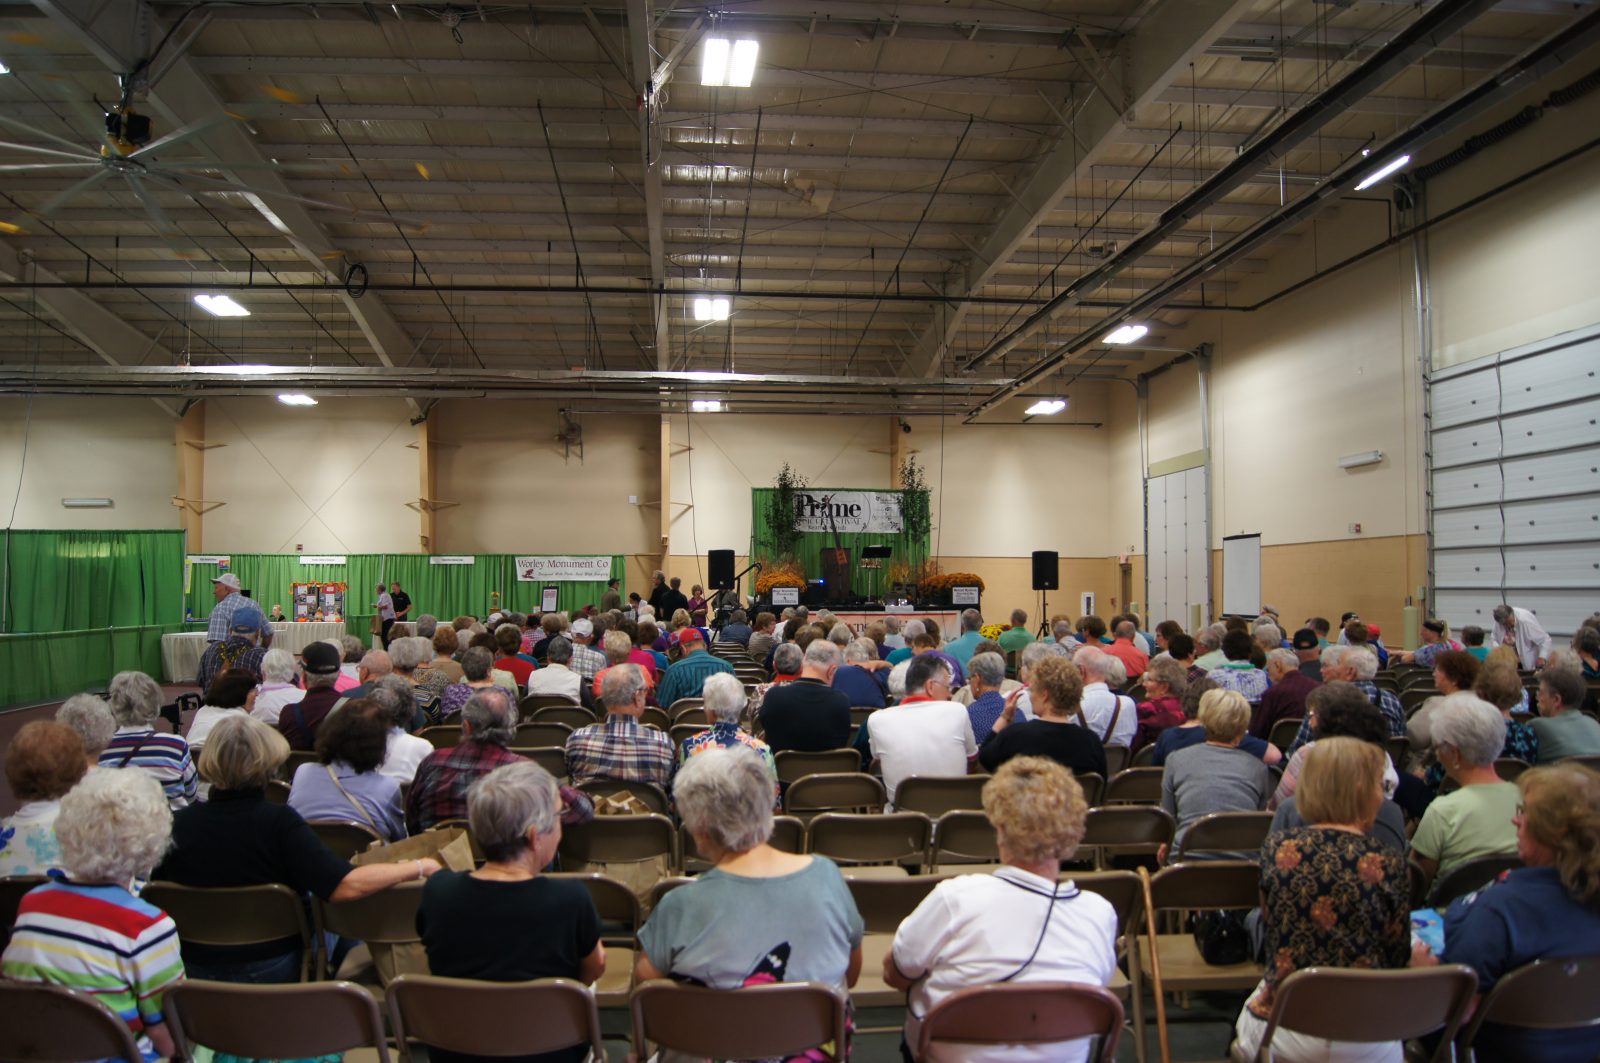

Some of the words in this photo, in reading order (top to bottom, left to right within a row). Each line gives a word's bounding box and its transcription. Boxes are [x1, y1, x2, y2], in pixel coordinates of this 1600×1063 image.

[518, 560, 545, 569] Worley
[548, 560, 593, 568] Monument
[597, 560, 608, 568] Co
